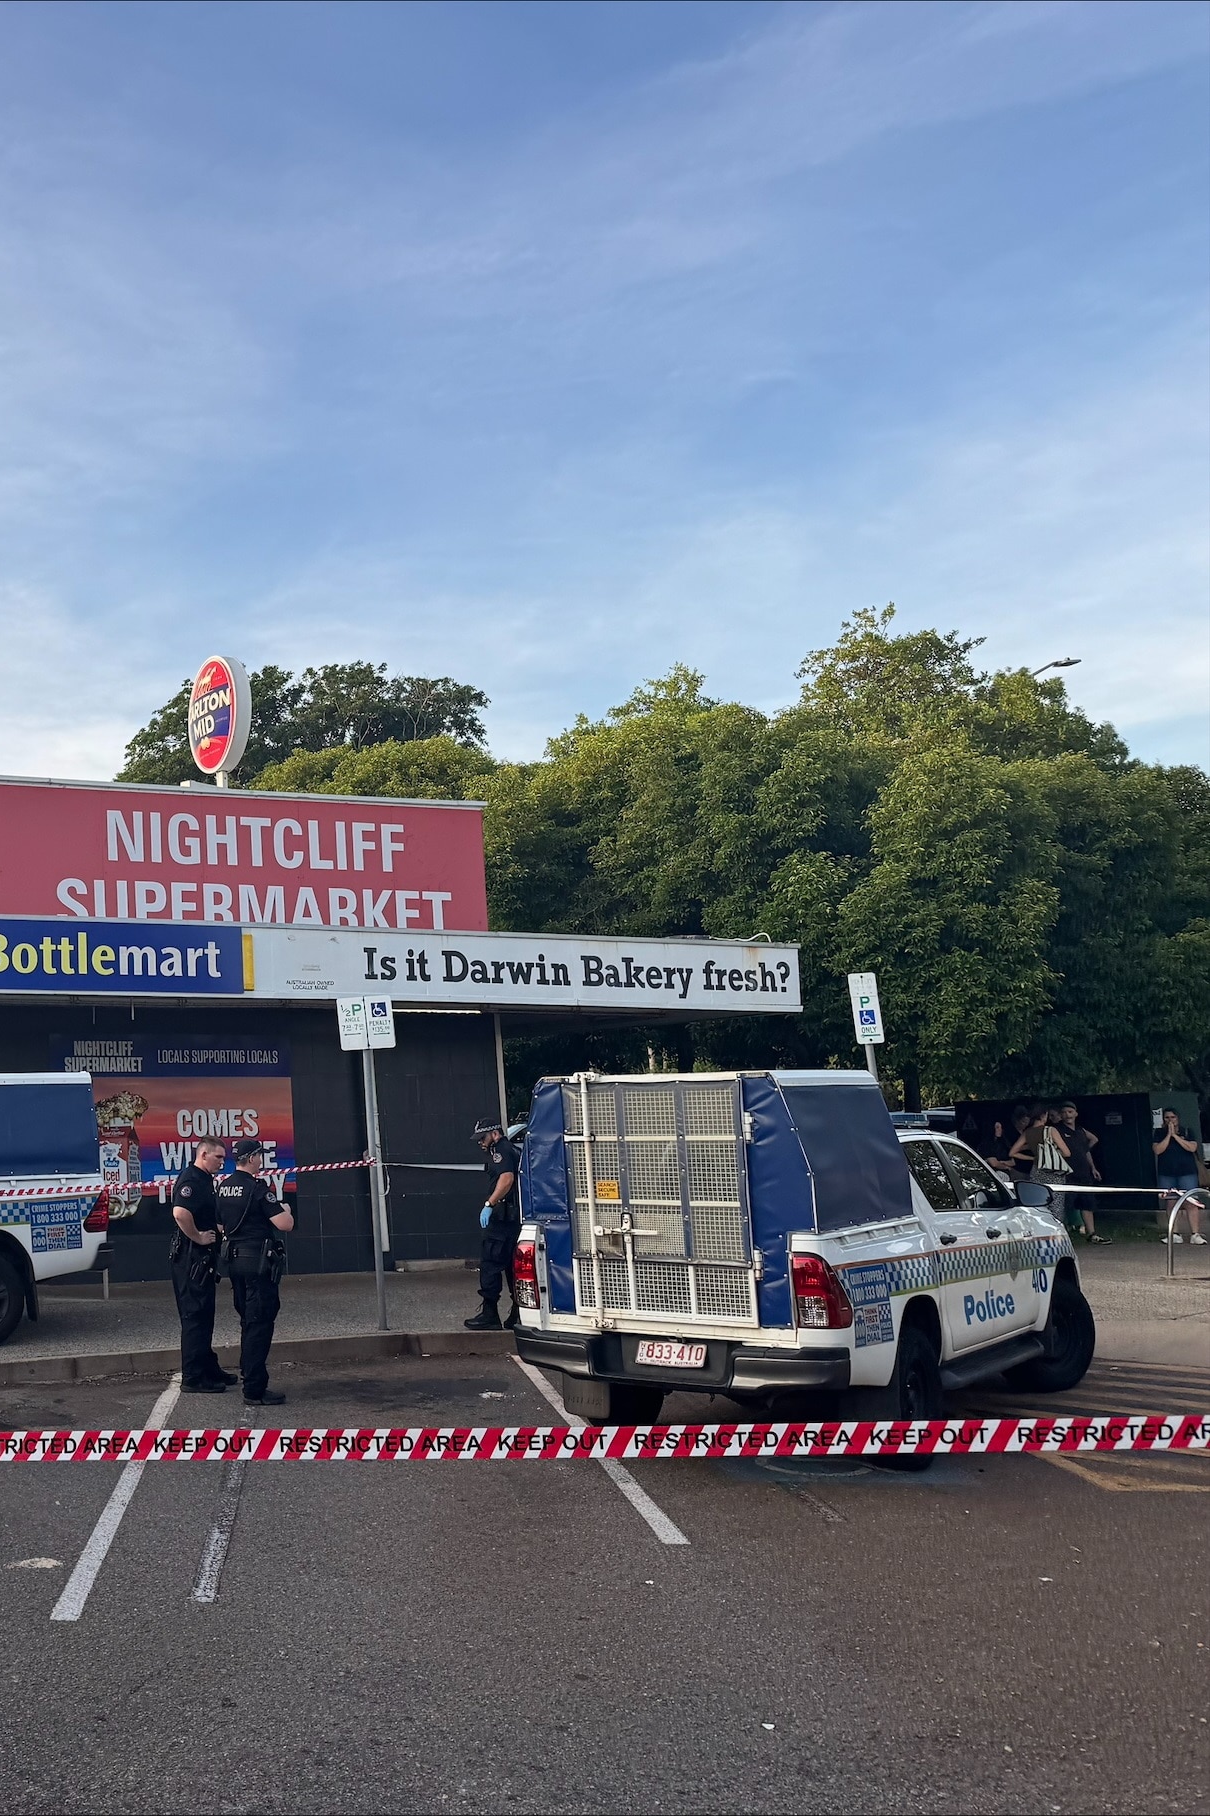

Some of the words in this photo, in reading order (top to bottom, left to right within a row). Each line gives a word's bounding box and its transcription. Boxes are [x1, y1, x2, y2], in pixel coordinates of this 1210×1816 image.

[190, 687, 231, 721] ARLTON
[193, 714, 215, 740] MID
[106, 809, 404, 873] NIGHTCLIFF
[56, 877, 451, 930] SUPERMARKET
[363, 946, 400, 981] Is
[404, 947, 431, 982] it
[440, 949, 571, 988] Darwin
[580, 955, 692, 998] Bakery
[702, 960, 789, 993] fresh?
[860, 996, 870, 1008] P
[74, 1041, 133, 1056] NIGHTCLIFF
[157, 1050, 190, 1063] LOCALS
[191, 1050, 245, 1063] SUPPORTING
[247, 1049, 278, 1064] LOCALS
[64, 1057, 143, 1072] SUPERMARKET
[177, 1109, 259, 1138] COMES
[103, 1168, 119, 1181] Iced
[219, 1186, 243, 1196] POLICE
[31, 1204, 48, 1213] CRIME
[49, 1202, 77, 1211] STOPPERS
[32, 1214, 50, 1224] 1800
[50, 1213, 64, 1223] 333
[65, 1212, 78, 1221] 000
[32, 1238, 45, 1247] 000
[862, 1269, 885, 1283] STOPPERS
[865, 1285, 875, 1300] 333
[876, 1283, 887, 1298] 000
[963, 1289, 1015, 1325] Police
[865, 1315, 878, 1324] FIRST
[866, 1324, 879, 1332] THEN
[867, 1332, 880, 1342] DIAL
[82, 1437, 139, 1454] AREA
[154, 1437, 208, 1453] KEEP
[213, 1437, 255, 1453] OUT
[280, 1436, 414, 1453] RESTRICTED
[421, 1435, 480, 1451] AREA
[498, 1433, 558, 1450] KEEP
[562, 1433, 608, 1450] OUT
[634, 1431, 779, 1450] RESTRICTED
[787, 1430, 852, 1448] AREA
[869, 1428, 932, 1446] KEEP
[939, 1428, 989, 1446] OUT
[1017, 1425, 1173, 1444] RESTRICTED
